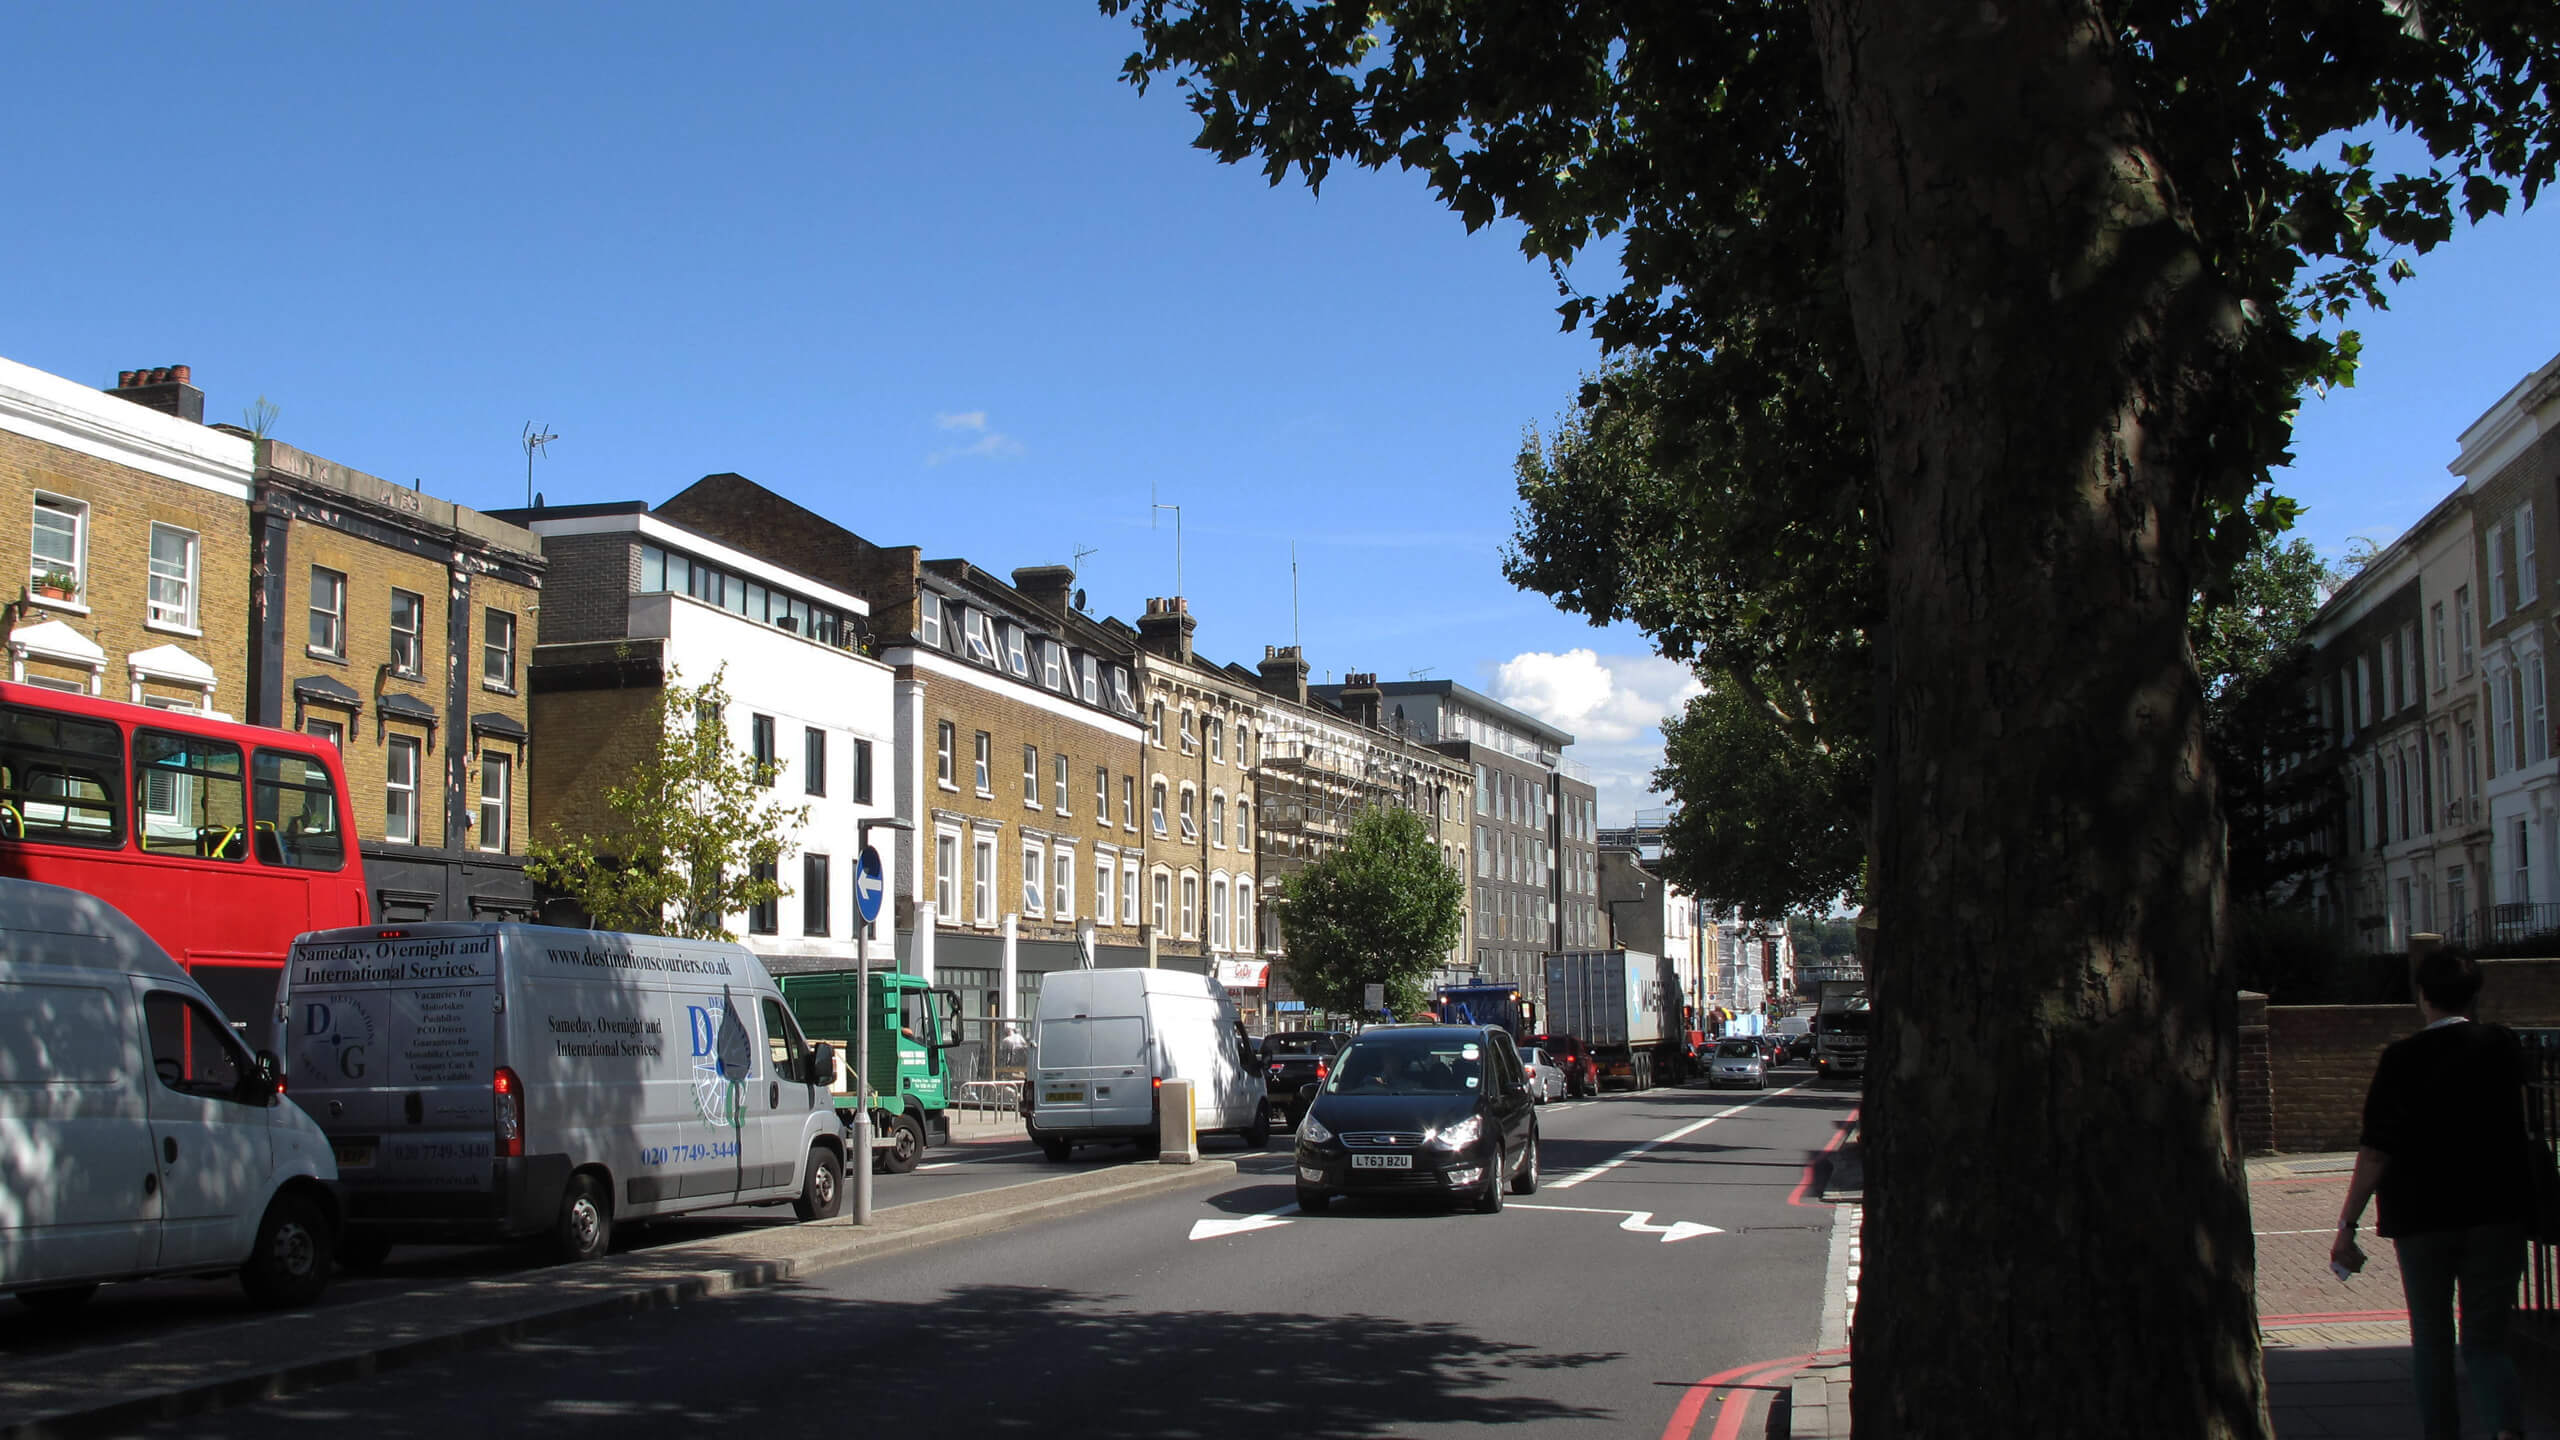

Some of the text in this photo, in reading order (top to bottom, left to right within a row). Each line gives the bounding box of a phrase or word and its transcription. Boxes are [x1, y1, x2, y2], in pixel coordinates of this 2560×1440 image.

[376, 941, 455, 960] Overnight
[460, 938, 490, 954] and
[547, 947, 732, 976] www.destinationscouriers.co.uk
[304, 964, 404, 983] International
[304, 1003, 331, 1036] D
[598, 1017, 643, 1039] Overnight
[646, 1018, 662, 1034] and
[687, 1005, 713, 1057] D
[557, 1040, 619, 1057] International
[341, 1044, 366, 1080] G
[641, 1147, 668, 1166] 020
[1356, 1156, 1408, 1167] LT63 BZU
